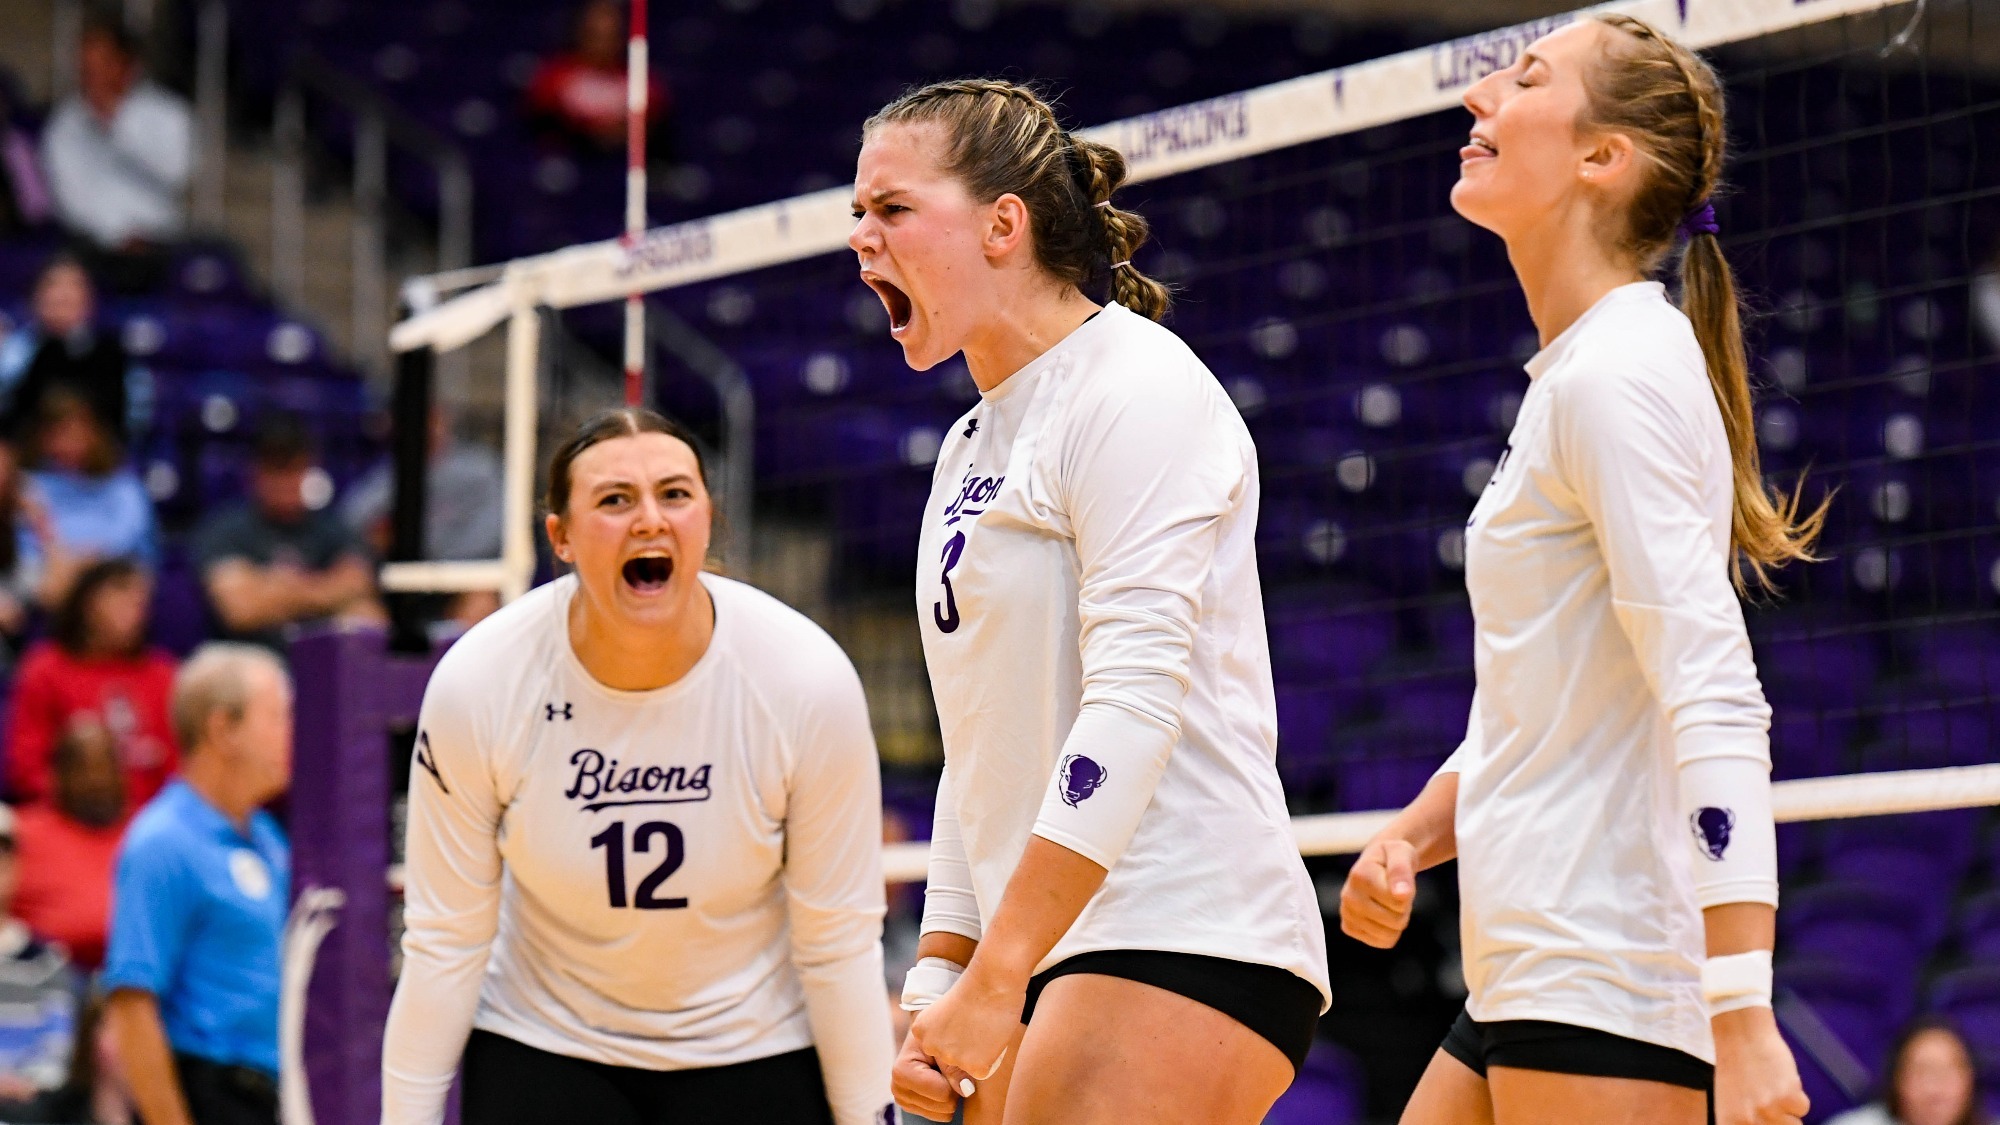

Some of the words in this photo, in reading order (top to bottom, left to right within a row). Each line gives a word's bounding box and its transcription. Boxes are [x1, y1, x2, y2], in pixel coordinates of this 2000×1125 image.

[944, 463, 1005, 526] son
[934, 531, 966, 633] 3
[565, 749, 712, 812] Bisons
[591, 821, 689, 910] 12
